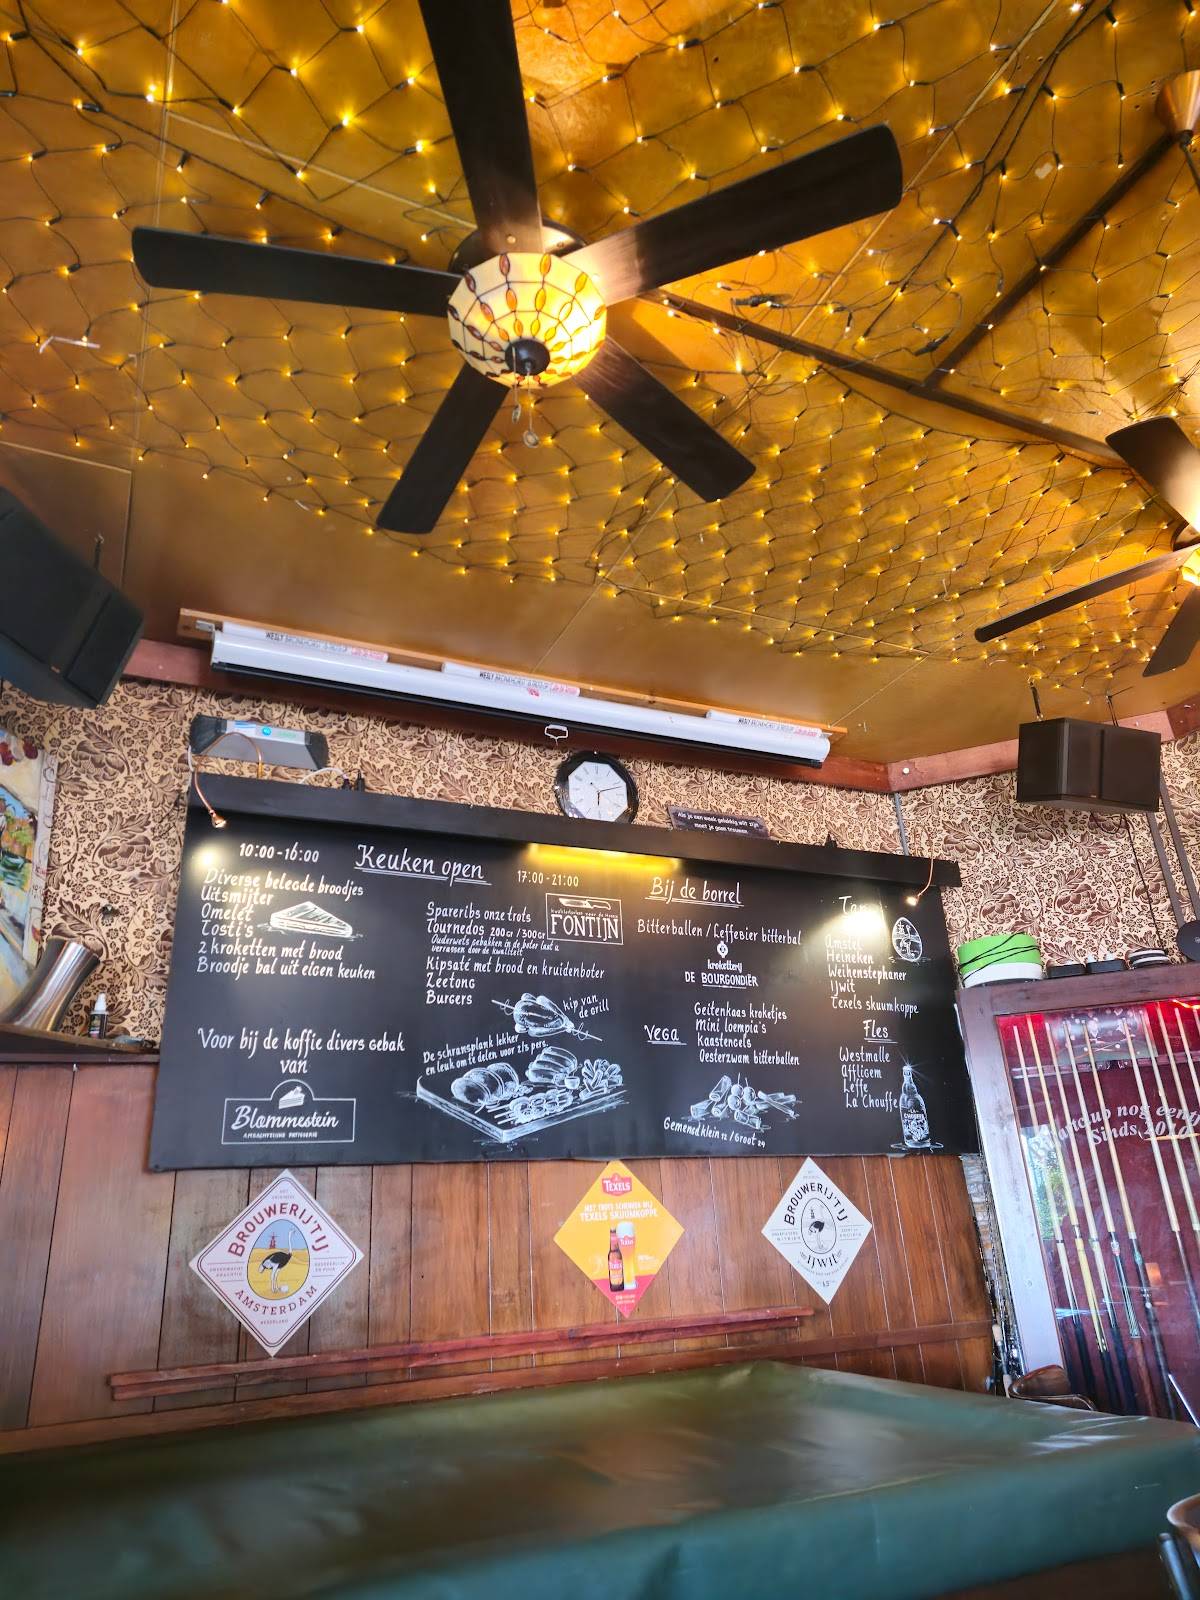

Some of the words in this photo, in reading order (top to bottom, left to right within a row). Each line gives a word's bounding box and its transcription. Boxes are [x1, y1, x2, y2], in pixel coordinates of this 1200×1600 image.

[355, 844, 436, 875] Keuken
[442, 861, 484, 887] open
[204, 867, 261, 887] Diverse
[265, 871, 314, 892] belegde
[318, 875, 364, 901] broodjes
[650, 876, 675, 904] Bij
[680, 878, 697, 900] de
[702, 880, 742, 904] borrel
[201, 886, 274, 906] Uitsmijter
[201, 903, 254, 922] Omelet
[426, 901, 481, 922] Spareribs
[484, 910, 505, 921] onze
[507, 905, 531, 923] trots
[201, 919, 254, 938] Tosti's
[426, 918, 485, 936] Tournedos
[550, 914, 619, 942] FONTIJN
[637, 918, 703, 937] Bitterballen
[761, 927, 802, 945] bitterbal
[198, 941, 207, 954] 2
[210, 938, 276, 957] kroketten
[281, 940, 304, 958] met
[309, 941, 344, 961] brood
[431, 933, 469, 946] Ouderwets
[504, 939, 512, 948] in
[512, 939, 520, 949] de
[431, 945, 465, 953] verrassen
[467, 945, 481, 954] door
[482, 946, 490, 955] de
[492, 947, 523, 957] kwaliteit
[825, 934, 864, 950] Amstel
[826, 949, 874, 964] Heineken
[196, 956, 249, 980] Broodje
[255, 958, 277, 975] bal
[280, 959, 300, 976] uit
[302, 961, 333, 977] eigen
[337, 963, 376, 979] keuken
[425, 956, 470, 976] Kipsaté
[473, 957, 492, 973] met
[495, 957, 525, 974] brood
[527, 965, 538, 975] en
[541, 959, 605, 979] kruidenboter
[828, 964, 907, 984] Weihenstephaner
[425, 972, 476, 989] Zeetong
[685, 971, 696, 983] DE
[701, 972, 759, 987] BOURGONDIËR
[830, 979, 856, 997] IJwit
[425, 989, 473, 1006] Burgers
[562, 998, 579, 1013] kip
[580, 993, 599, 1006] van
[830, 994, 863, 1010] Texels
[866, 995, 919, 1020] skuumkoppe
[578, 1007, 589, 1019] de
[590, 999, 610, 1016] grill
[694, 1001, 746, 1018] Geitenkaas
[749, 1002, 788, 1024] kroketjes
[695, 1018, 720, 1033] Mini
[724, 1018, 767, 1035] loempia's
[862, 1019, 889, 1039] Fles
[197, 1027, 234, 1049] Voor
[239, 1027, 258, 1059] bij
[263, 1028, 279, 1050] de
[283, 1027, 322, 1058] koffie
[326, 1029, 366, 1051] divers
[368, 1032, 405, 1052] gebak
[423, 1051, 436, 1064] De
[437, 1034, 494, 1060] schransplank
[496, 1031, 520, 1047] lekker
[425, 1066, 436, 1077] en
[437, 1059, 455, 1073] leuk
[456, 1059, 467, 1069] om
[468, 1054, 477, 1065] te
[477, 1048, 498, 1063] delen
[499, 1047, 515, 1058] voor
[699, 1048, 751, 1064] Oesterzwam
[753, 1049, 800, 1066] bitterballen
[839, 1045, 891, 1063] Westmalle
[279, 1059, 308, 1074] van
[841, 1064, 883, 1082] Affligem
[843, 1078, 869, 1098] Leffe
[846, 1092, 859, 1109] La
[862, 1090, 898, 1113] Chouffe
[1116, 1104, 1150, 1120] nog
[700, 1123, 720, 1139] klein
[734, 1132, 757, 1147] Groot
[1091, 1122, 1138, 1145] Sinds
[603, 1180, 631, 1192] TEXELS
[580, 1211, 608, 1222] TEXELS
[610, 1208, 658, 1220] SKUUMKOPPE
[235, 1285, 318, 1316] AMSTERDAM
